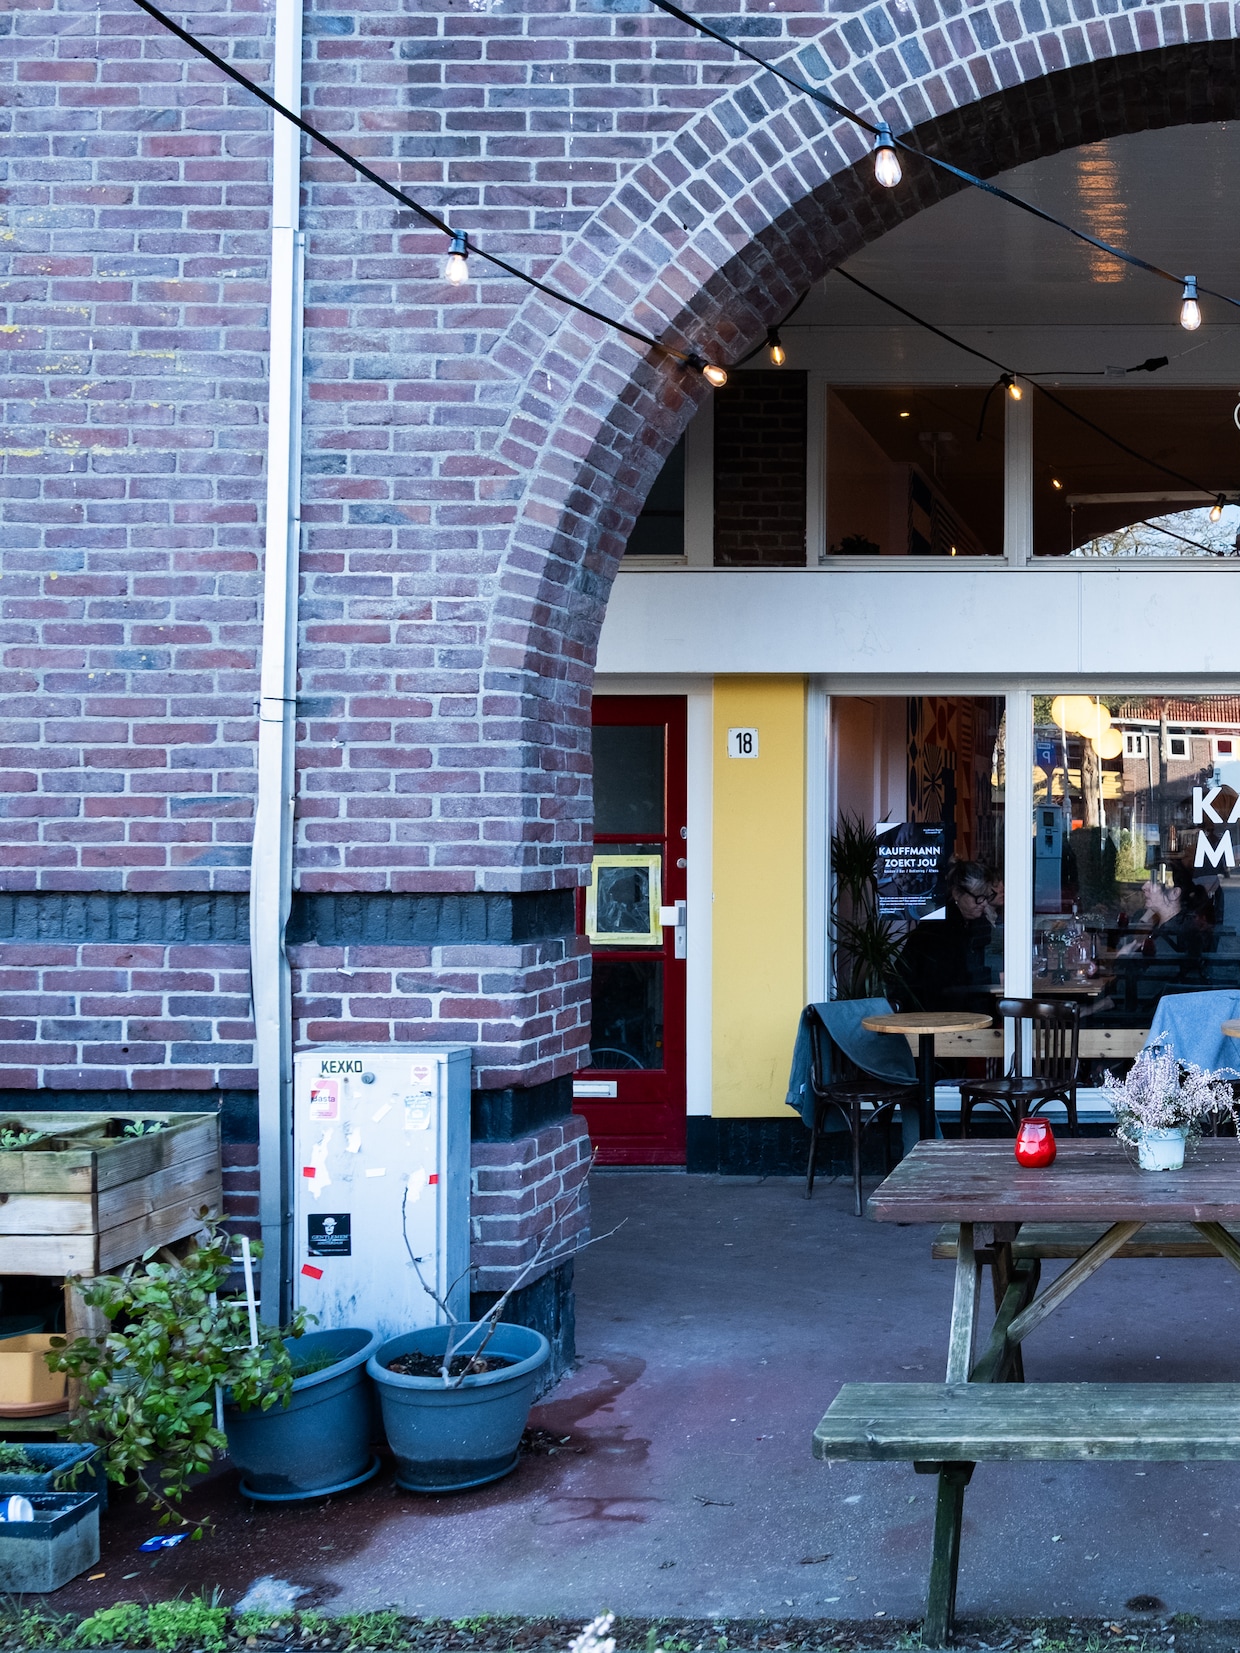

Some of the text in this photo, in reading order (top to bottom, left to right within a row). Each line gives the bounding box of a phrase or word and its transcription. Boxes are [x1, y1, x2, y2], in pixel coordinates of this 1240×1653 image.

[736, 732, 752, 754] 18
[878, 846, 941, 856] KAUFFMANN
[885, 858, 937, 868] ZOEKT JOU
[321, 1060, 363, 1073] KEXKO
